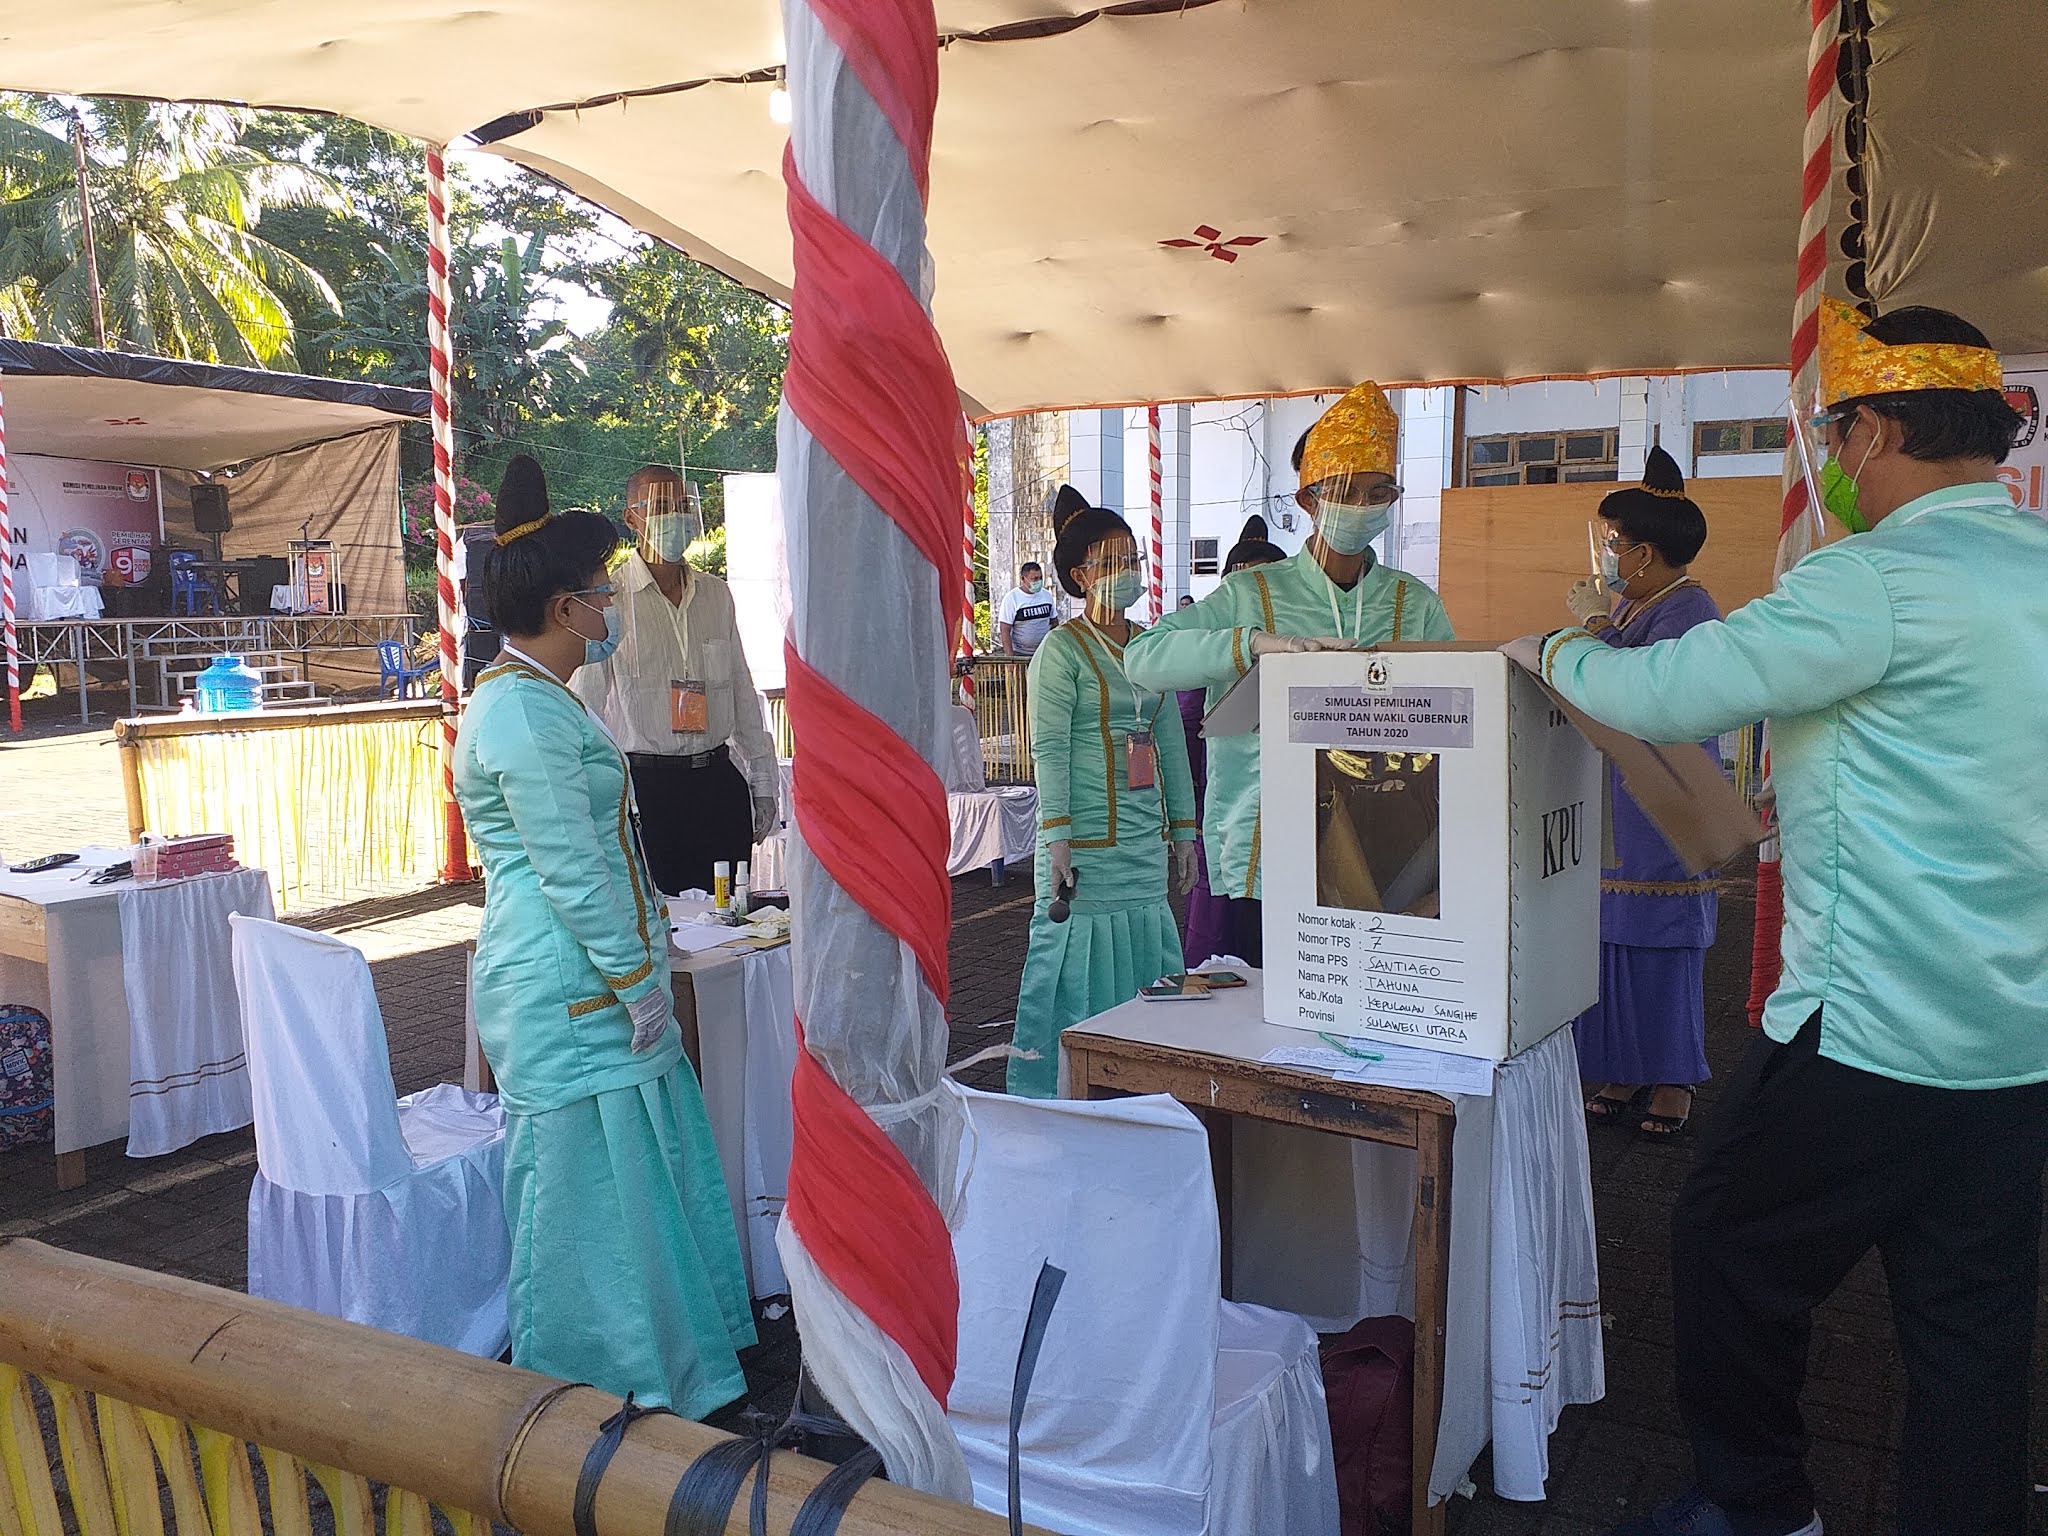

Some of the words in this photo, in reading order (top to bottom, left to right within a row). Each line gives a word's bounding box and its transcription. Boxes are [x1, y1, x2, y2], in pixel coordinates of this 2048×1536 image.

[111, 531, 151, 539] PEMILIHAN
[116, 556, 132, 575] 9
[1023, 605, 1050, 618] ETERNITY
[1325, 697, 1371, 707] SIMULASI
[1374, 698, 1431, 708] PEMILIHAN
[1293, 711, 1346, 721] GUBERNUR
[1349, 713, 1371, 722] DAN
[1373, 713, 1406, 722] WAKIL
[1408, 714, 1469, 724] GUBERNUR
[1346, 727, 1381, 737] TAHUN
[1384, 729, 1408, 738] 2020
[1541, 800, 1584, 880] KPU
[1298, 912, 1329, 926] Nomor
[1330, 915, 1356, 929] kotak
[1368, 916, 1386, 931] 2
[1298, 931, 1329, 945] Nomor
[1330, 935, 1351, 948] TPS
[1370, 936, 1383, 950] 7
[1298, 950, 1325, 964] Nama
[1327, 953, 1348, 967] PPS
[1368, 956, 1441, 977] SANTIAGO
[1298, 968, 1325, 983] Nama
[1327, 973, 1349, 987] PPK
[1366, 976, 1420, 994] TAHUNA
[1298, 987, 1343, 1005] Kab./Kota
[1299, 1006, 1335, 1023] Provinsi
[1434, 1004, 1478, 1021] SANGIHE
[1366, 1016, 1420, 1034] SULAWESI
[1426, 1024, 1469, 1041] UTARA
